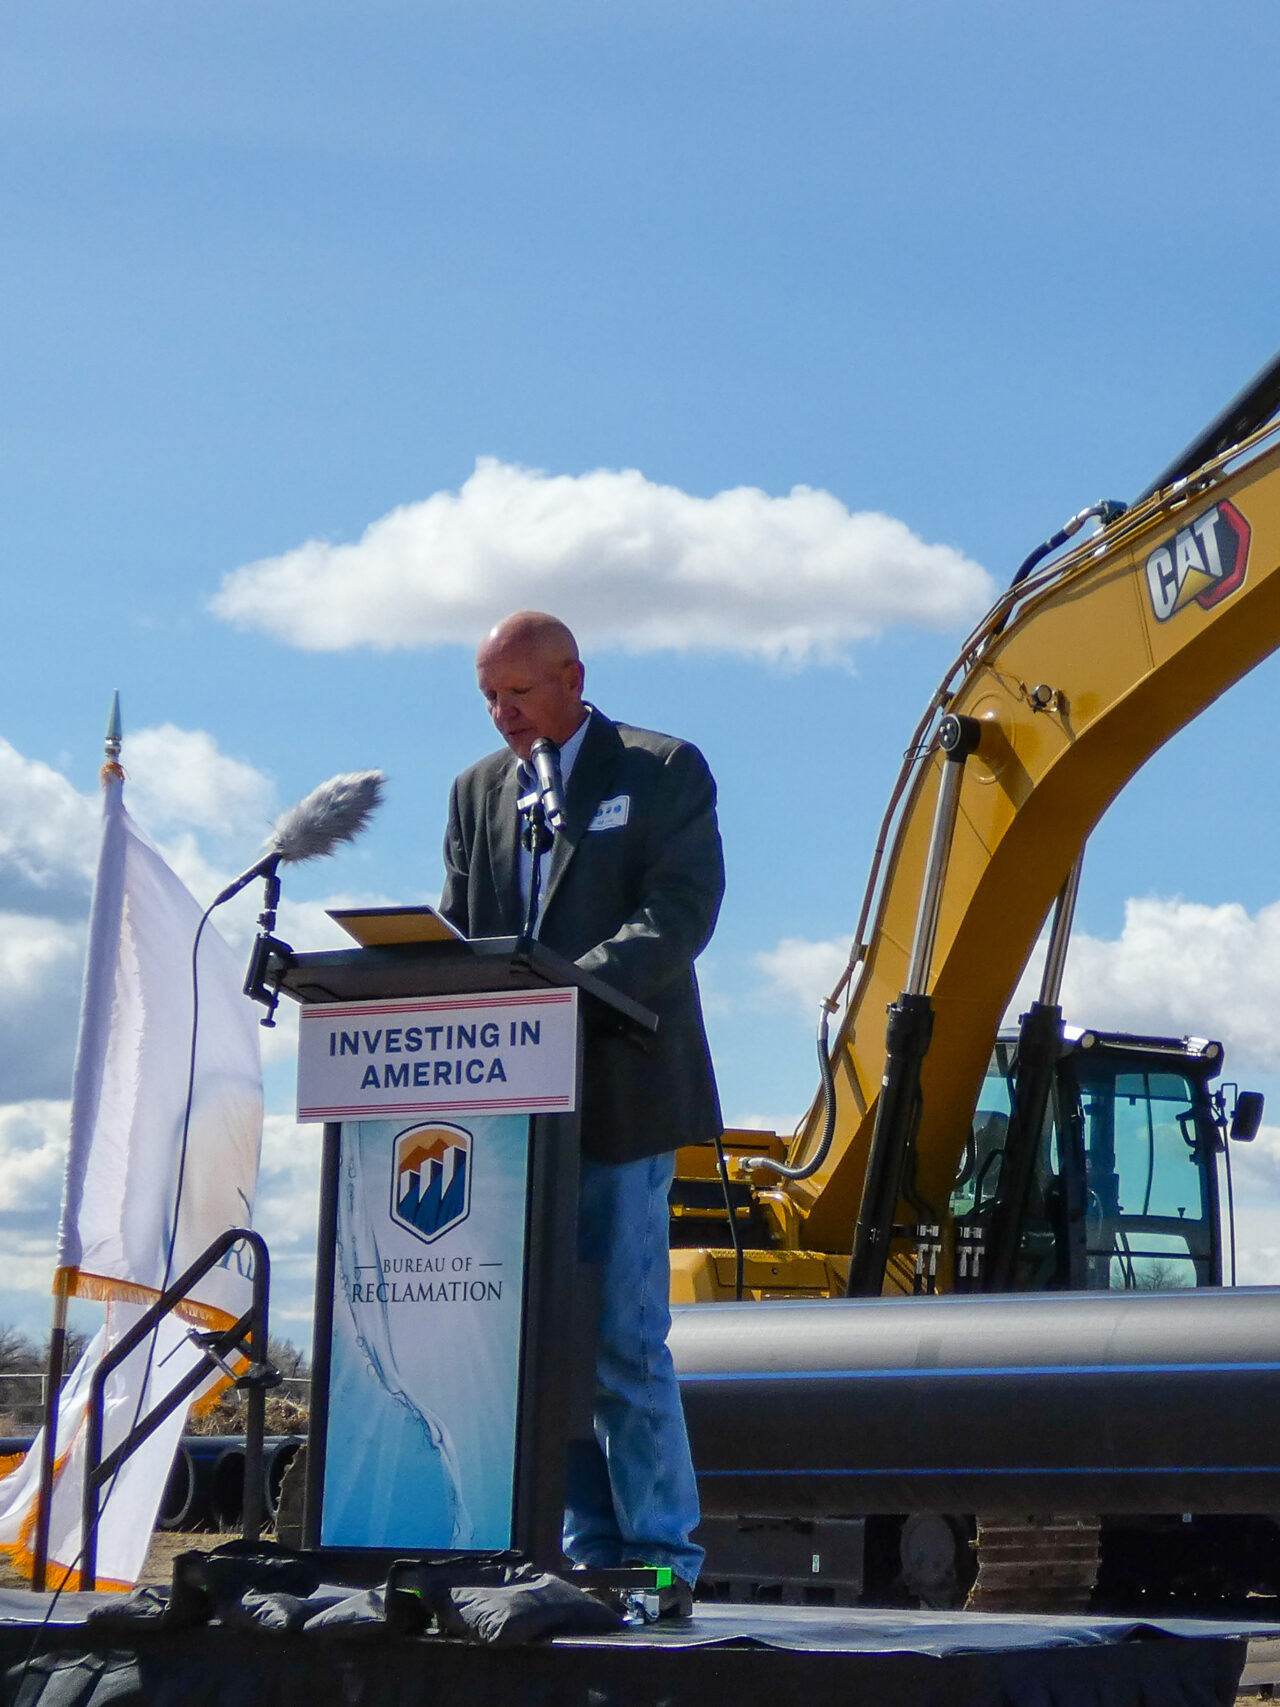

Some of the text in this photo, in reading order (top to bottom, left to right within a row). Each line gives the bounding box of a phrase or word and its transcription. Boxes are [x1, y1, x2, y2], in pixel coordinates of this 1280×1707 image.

[1146, 506, 1224, 621] CAT
[329, 1020, 541, 1057] INVESTING IN
[360, 1057, 508, 1090] AMERICA
[383, 1256, 473, 1274] BUREAU OF
[351, 1280, 503, 1304] RECLAMATION
